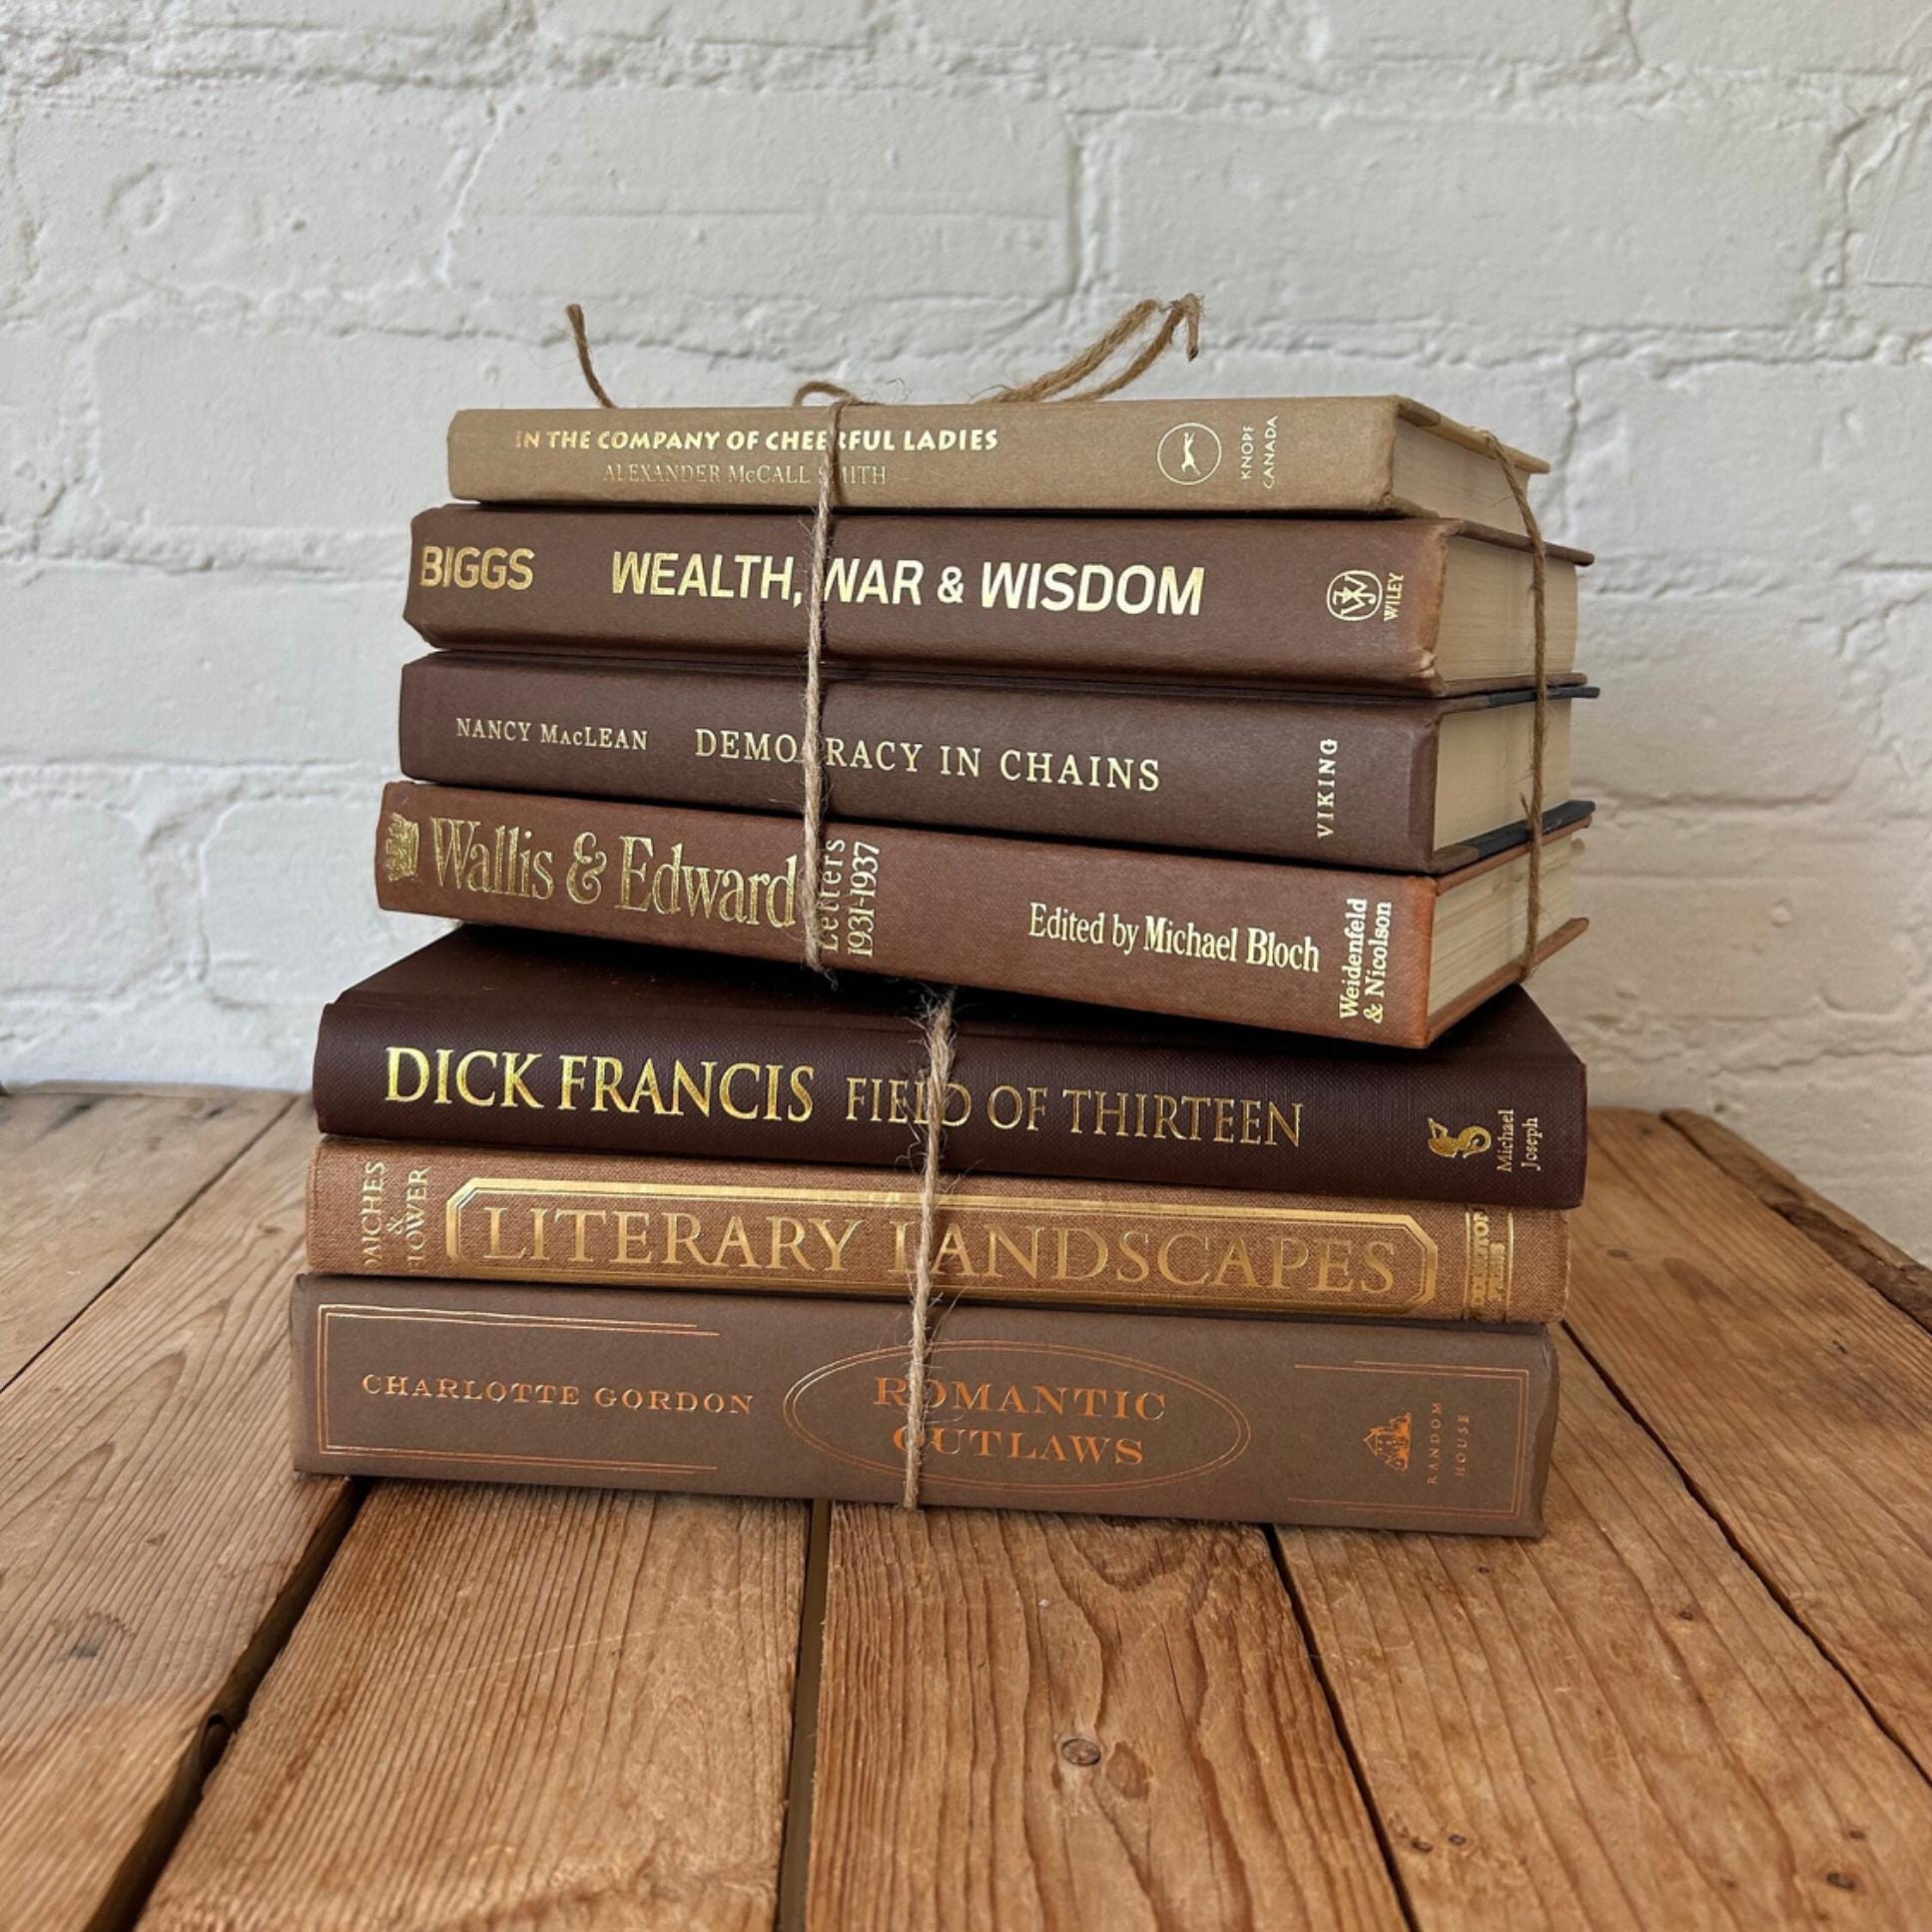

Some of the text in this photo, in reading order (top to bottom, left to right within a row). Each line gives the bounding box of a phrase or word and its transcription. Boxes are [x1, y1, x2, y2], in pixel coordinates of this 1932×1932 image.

[515, 430, 540, 448] IN
[546, 430, 591, 449] THE
[597, 430, 720, 450] COMPANY
[726, 429, 761, 450] OF
[903, 428, 998, 451] LADIES
[1240, 423, 1254, 480] KNOPF
[1262, 414, 1279, 489] CANADA
[603, 463, 886, 485] ALEXANDER McCALL ITH
[419, 545, 535, 591] BIGGS
[611, 550, 1205, 616] WEALTH, WAR & WISDOM
[1383, 571, 1405, 622] WILEY
[456, 718, 649, 751] NANCY MacLEAN
[695, 728, 1161, 793] DEMORACY IN CHAINS
[1316, 738, 1338, 840] VIKING
[429, 817, 799, 929] Wallis & Edward
[847, 841, 881, 959] 1931-1937
[1028, 902, 1321, 972] Edited by Michael Bloch
[1339, 898, 1369, 1019] Weidenfeld
[1363, 902, 1393, 1023] & Nicolson
[384, 1045, 1304, 1148] DICK FRANCIS FIELD OF THIRTEEN
[1497, 1109, 1515, 1172] Michael
[1521, 1117, 1544, 1171] Joseph
[386, 1216, 405, 1235] &
[483, 1206, 864, 1273] LITERARY
[887, 1220, 1396, 1295] LANDSCAPES
[361, 1373, 754, 1416] CHARLOTTE GORDON
[873, 1377, 1167, 1422] ROMANTIC
[1427, 1402, 1443, 1486] RANDOM
[1455, 1414, 1470, 1477] HOUSE
